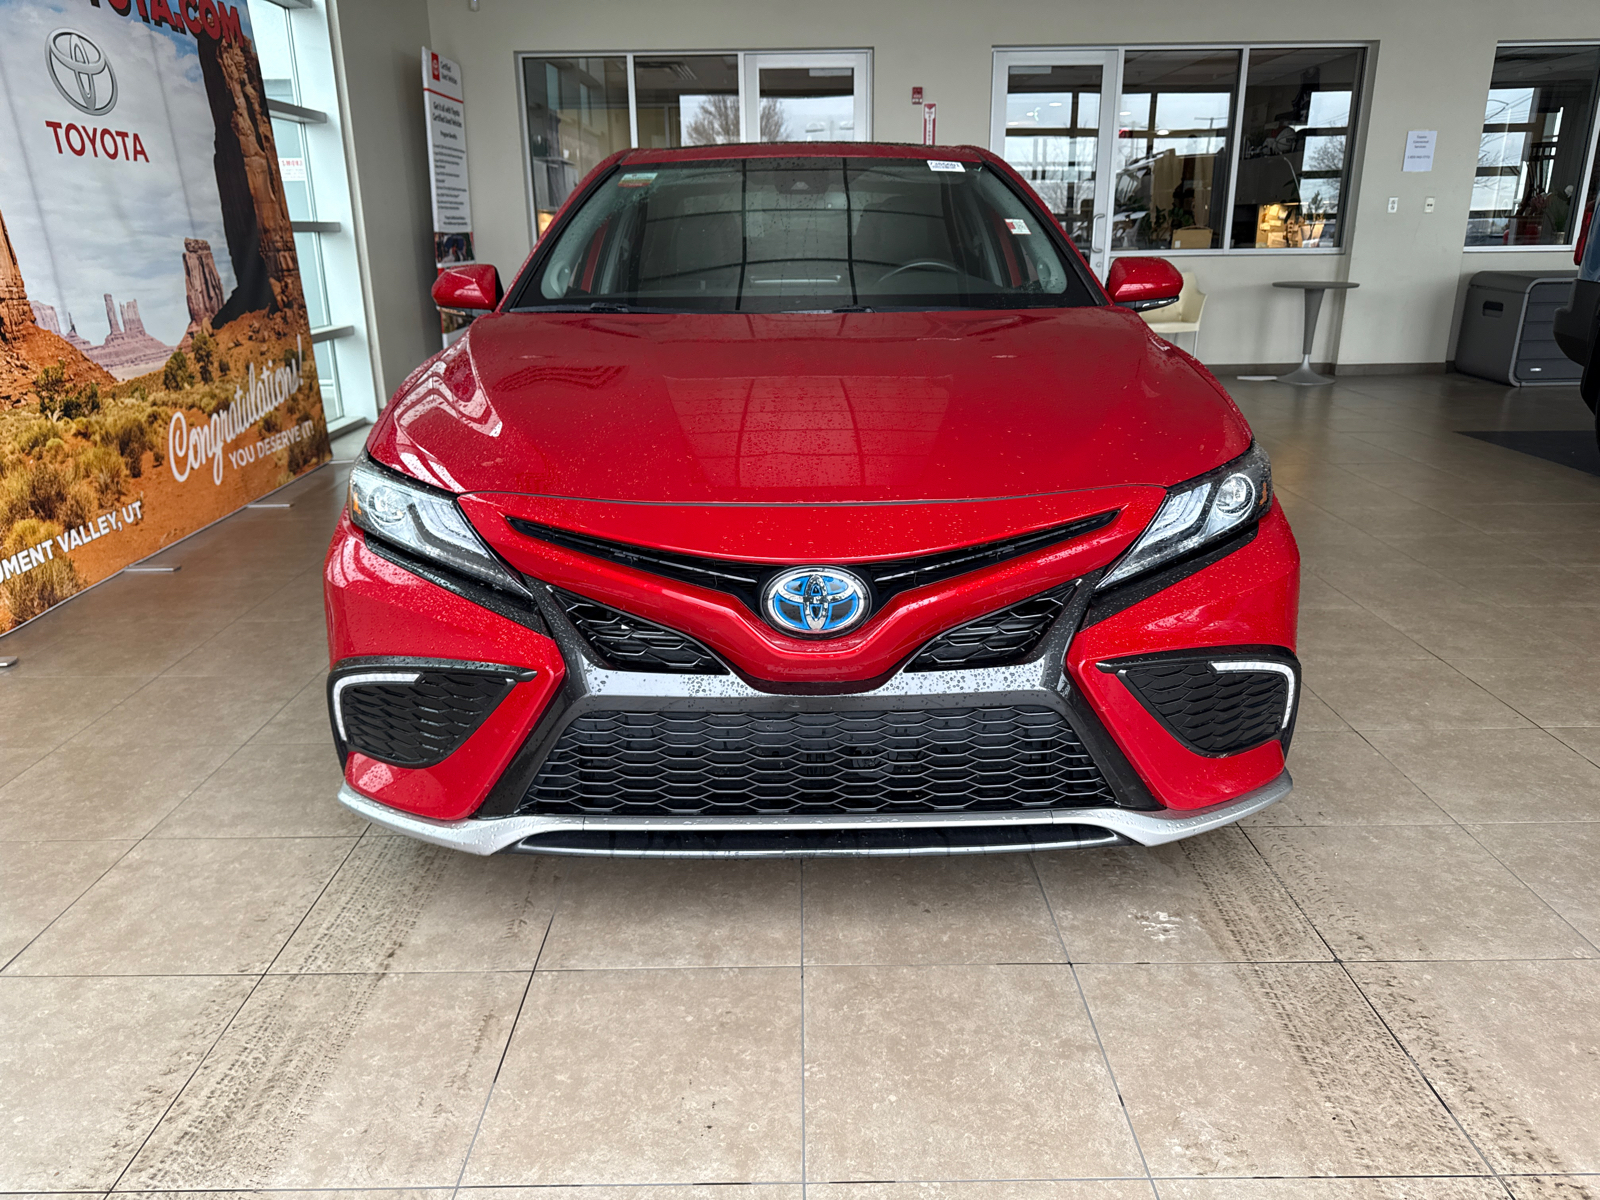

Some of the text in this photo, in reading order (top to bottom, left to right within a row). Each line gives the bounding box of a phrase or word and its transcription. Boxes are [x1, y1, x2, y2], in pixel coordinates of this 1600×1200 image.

[45, 120, 150, 163] TOYOTA
[169, 334, 303, 486] Congratulations!
[228, 419, 315, 470] YOU DESERVE IT!
[0, 501, 142, 584] MENT VALLEY, UT
